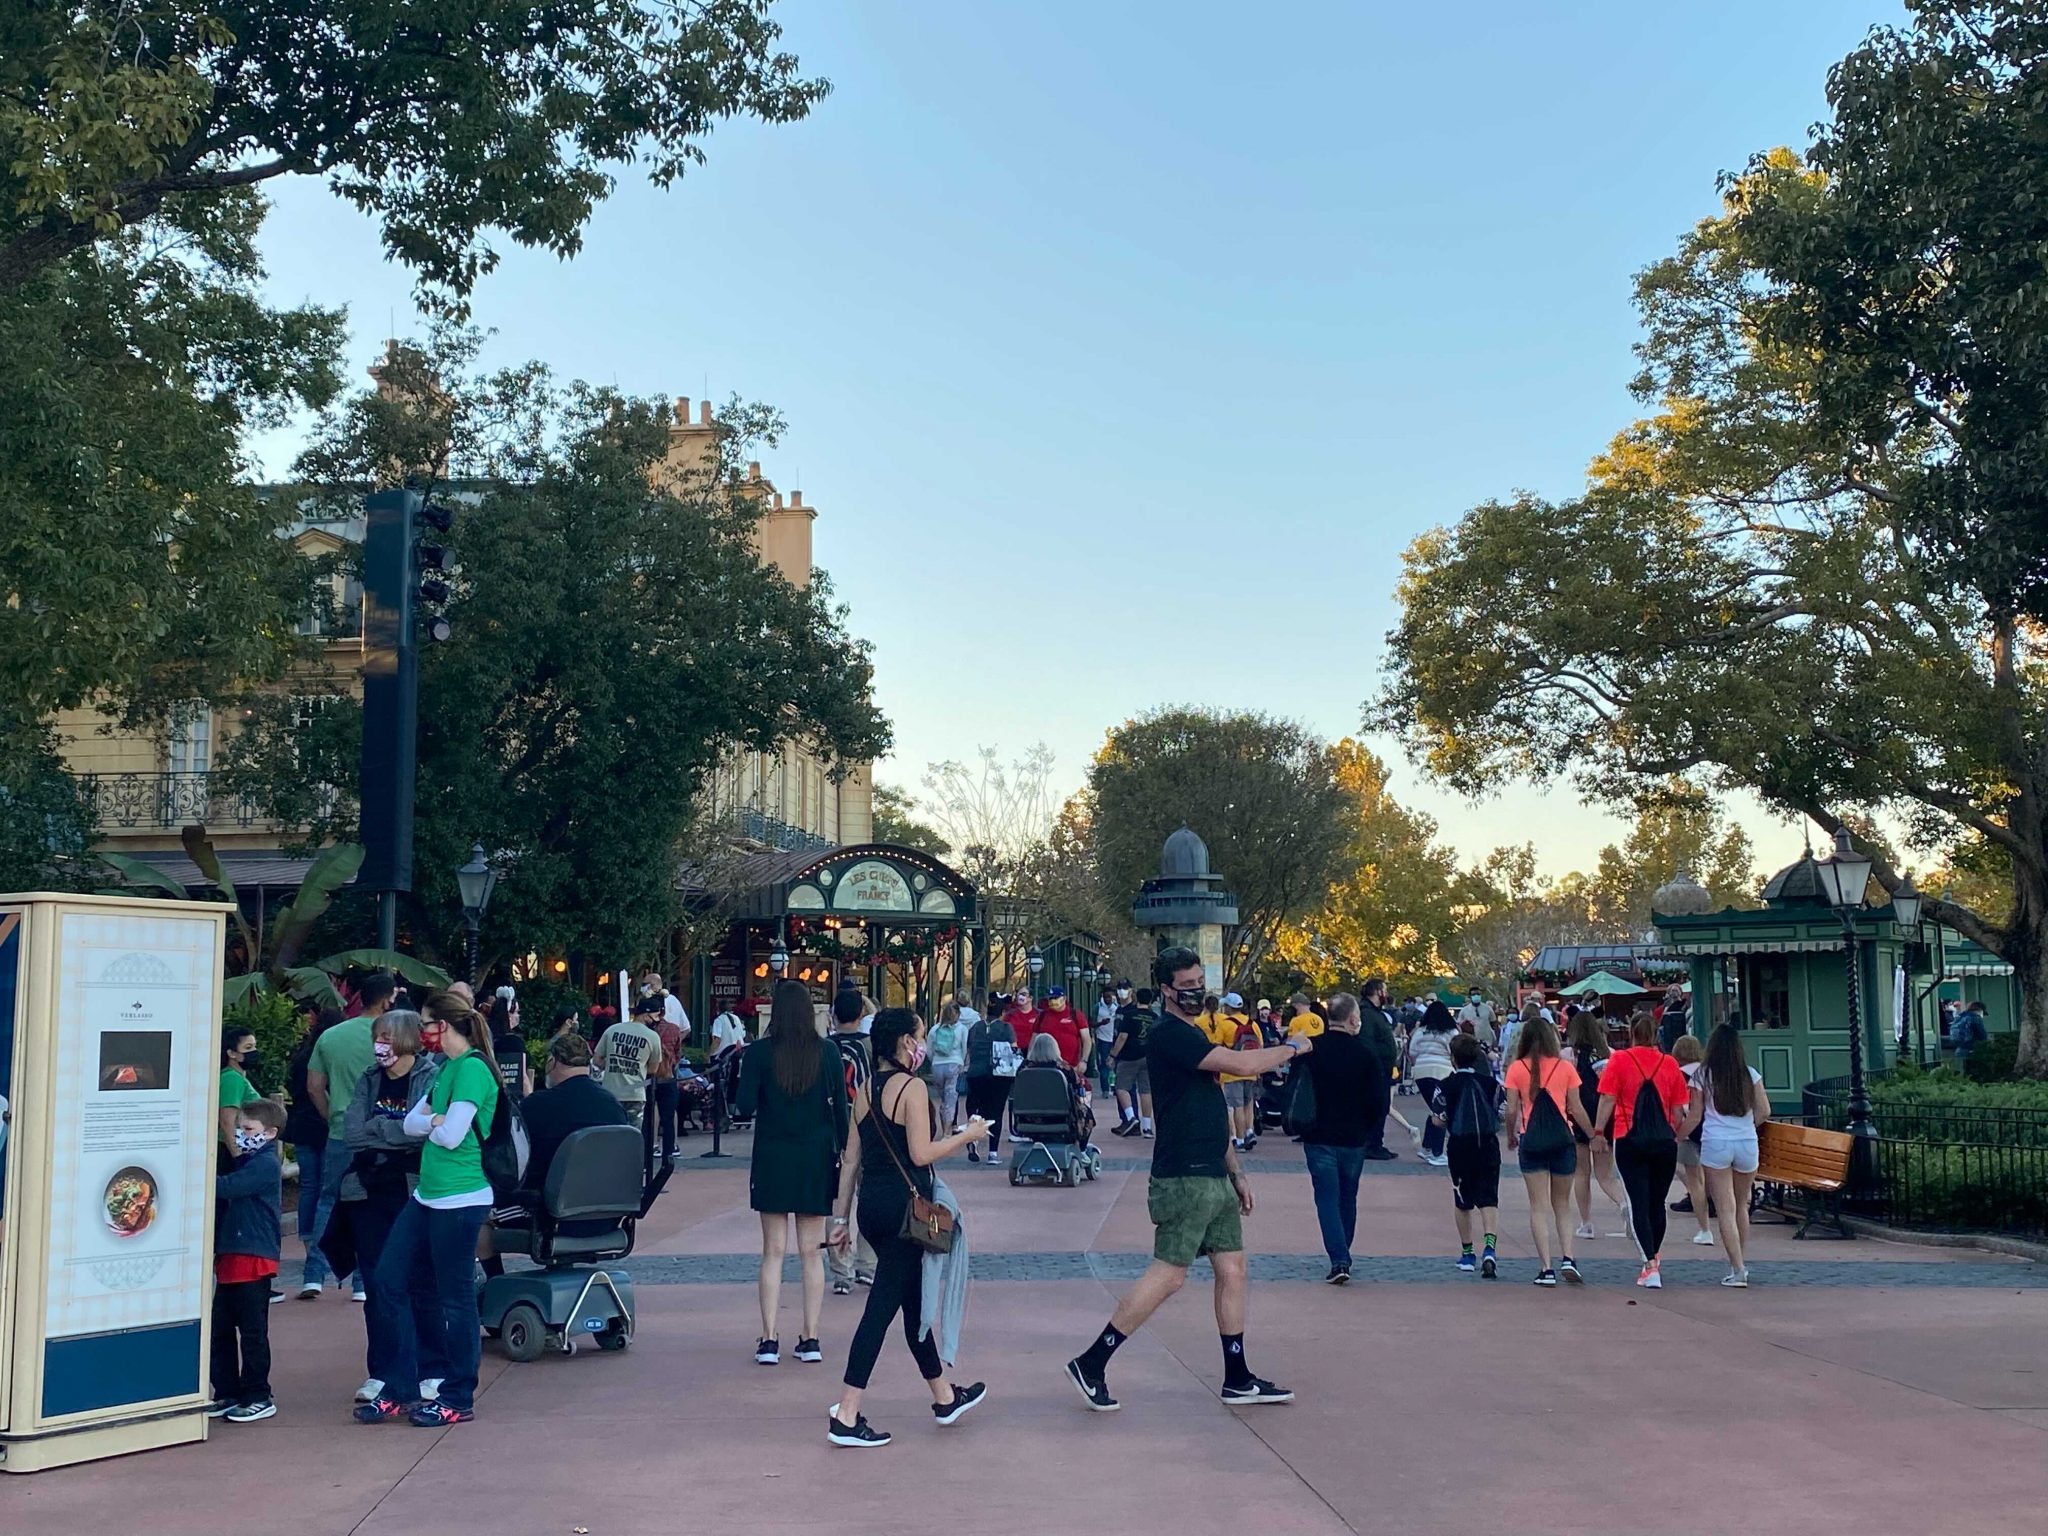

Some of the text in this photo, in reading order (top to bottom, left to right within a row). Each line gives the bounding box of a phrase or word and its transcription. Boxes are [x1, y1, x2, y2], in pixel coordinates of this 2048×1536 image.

[848, 871, 866, 886] LES
[857, 890, 890, 901] FRANCE
[714, 975, 738, 985] SERVICE
[723, 986, 741, 995] CARTE
[611, 1032, 647, 1049] ROUND
[615, 1042, 639, 1059] TWO
